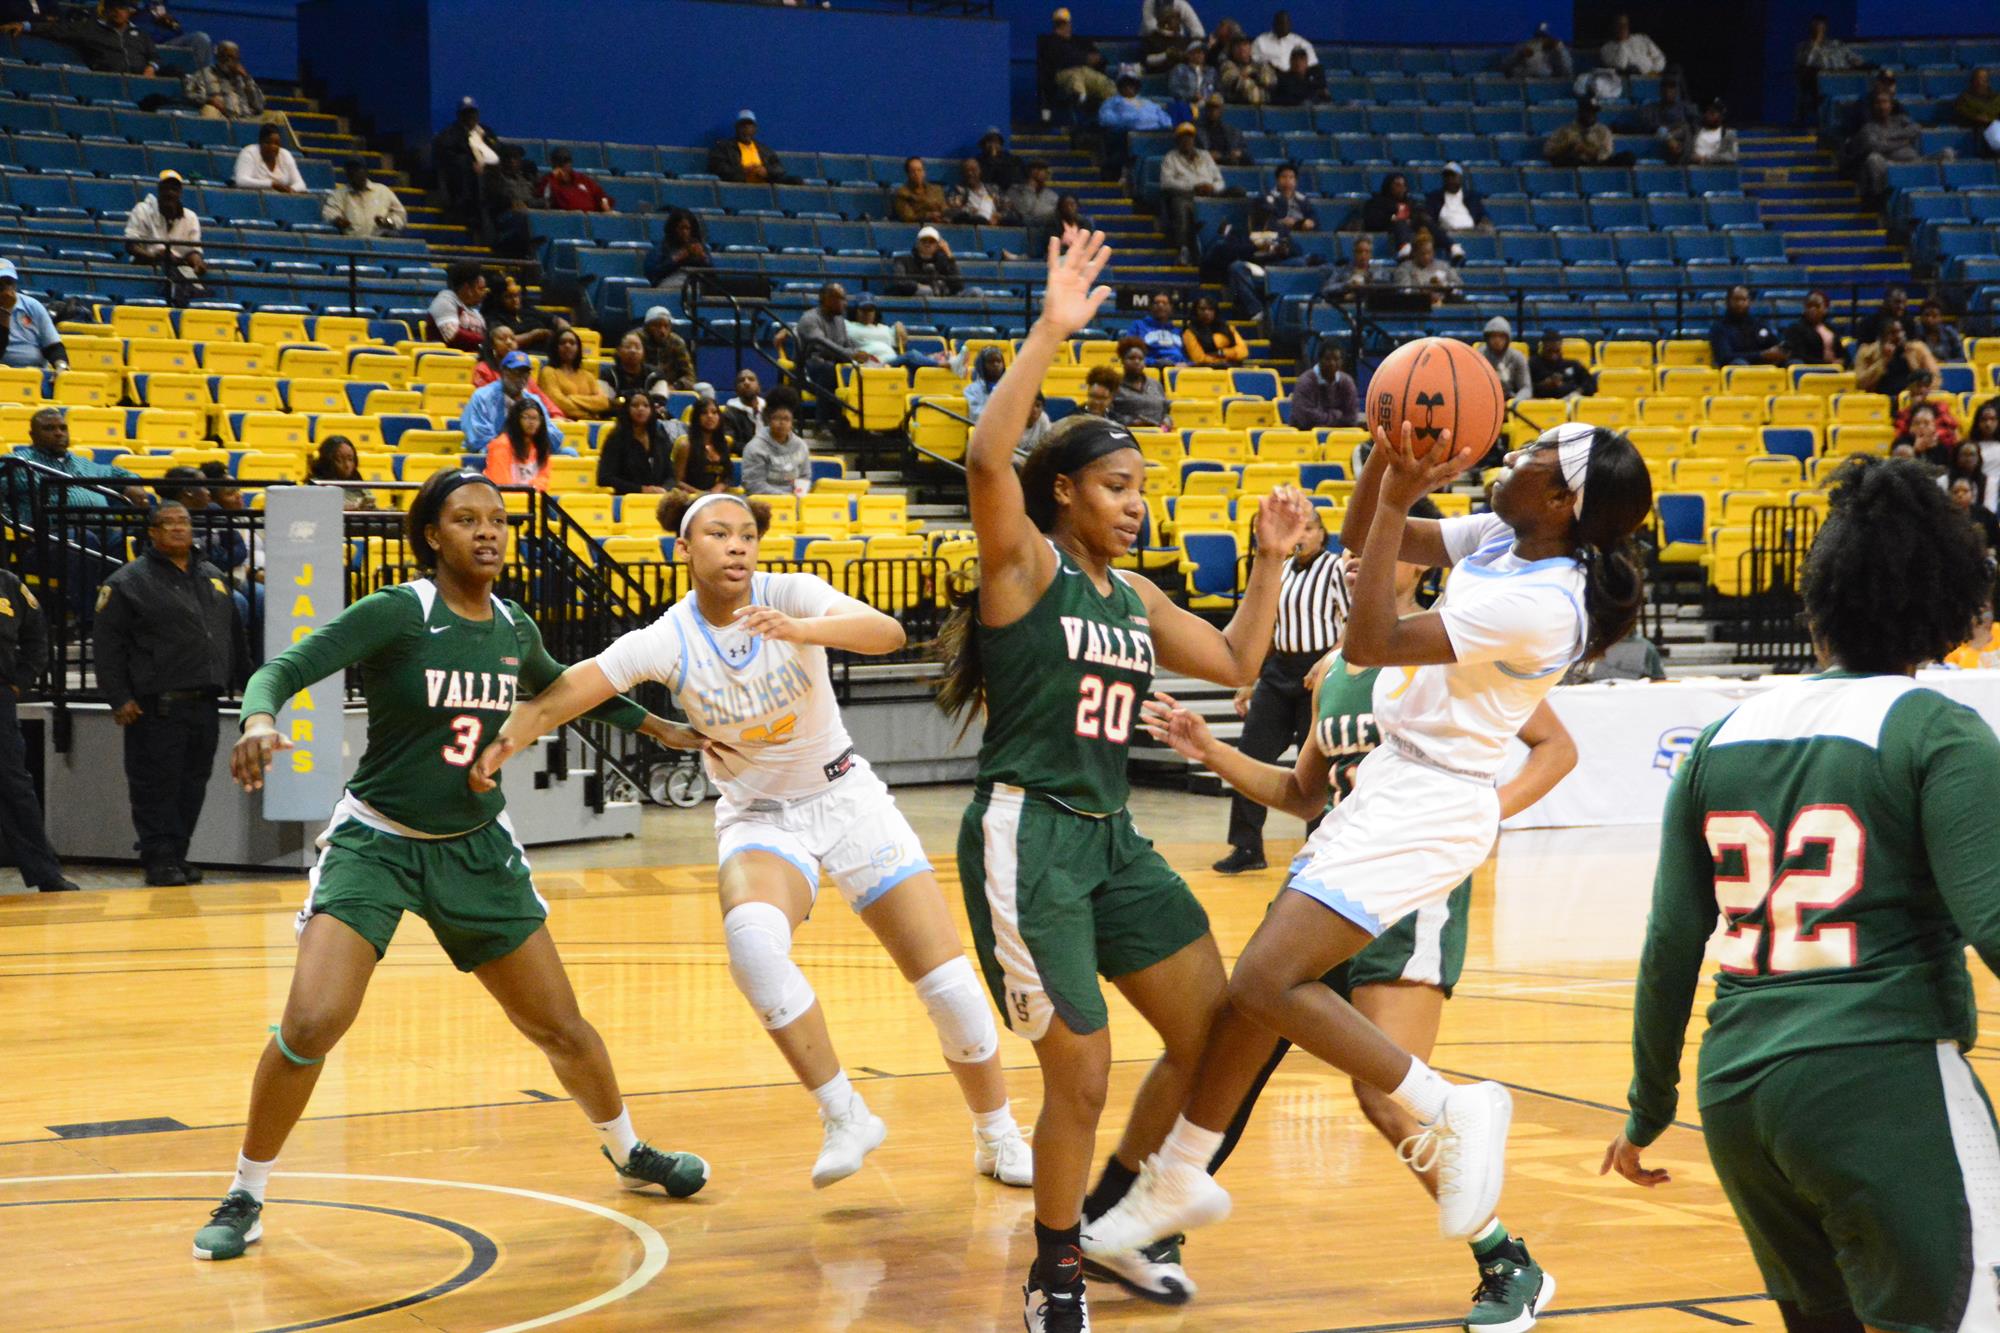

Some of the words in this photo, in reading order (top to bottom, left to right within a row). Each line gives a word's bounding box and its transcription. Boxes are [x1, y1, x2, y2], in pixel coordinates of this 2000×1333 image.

[698, 656, 813, 727] SOUTHERN
[1074, 673, 1136, 744] 20
[441, 713, 482, 767] 3
[1703, 803, 1867, 976] 22
